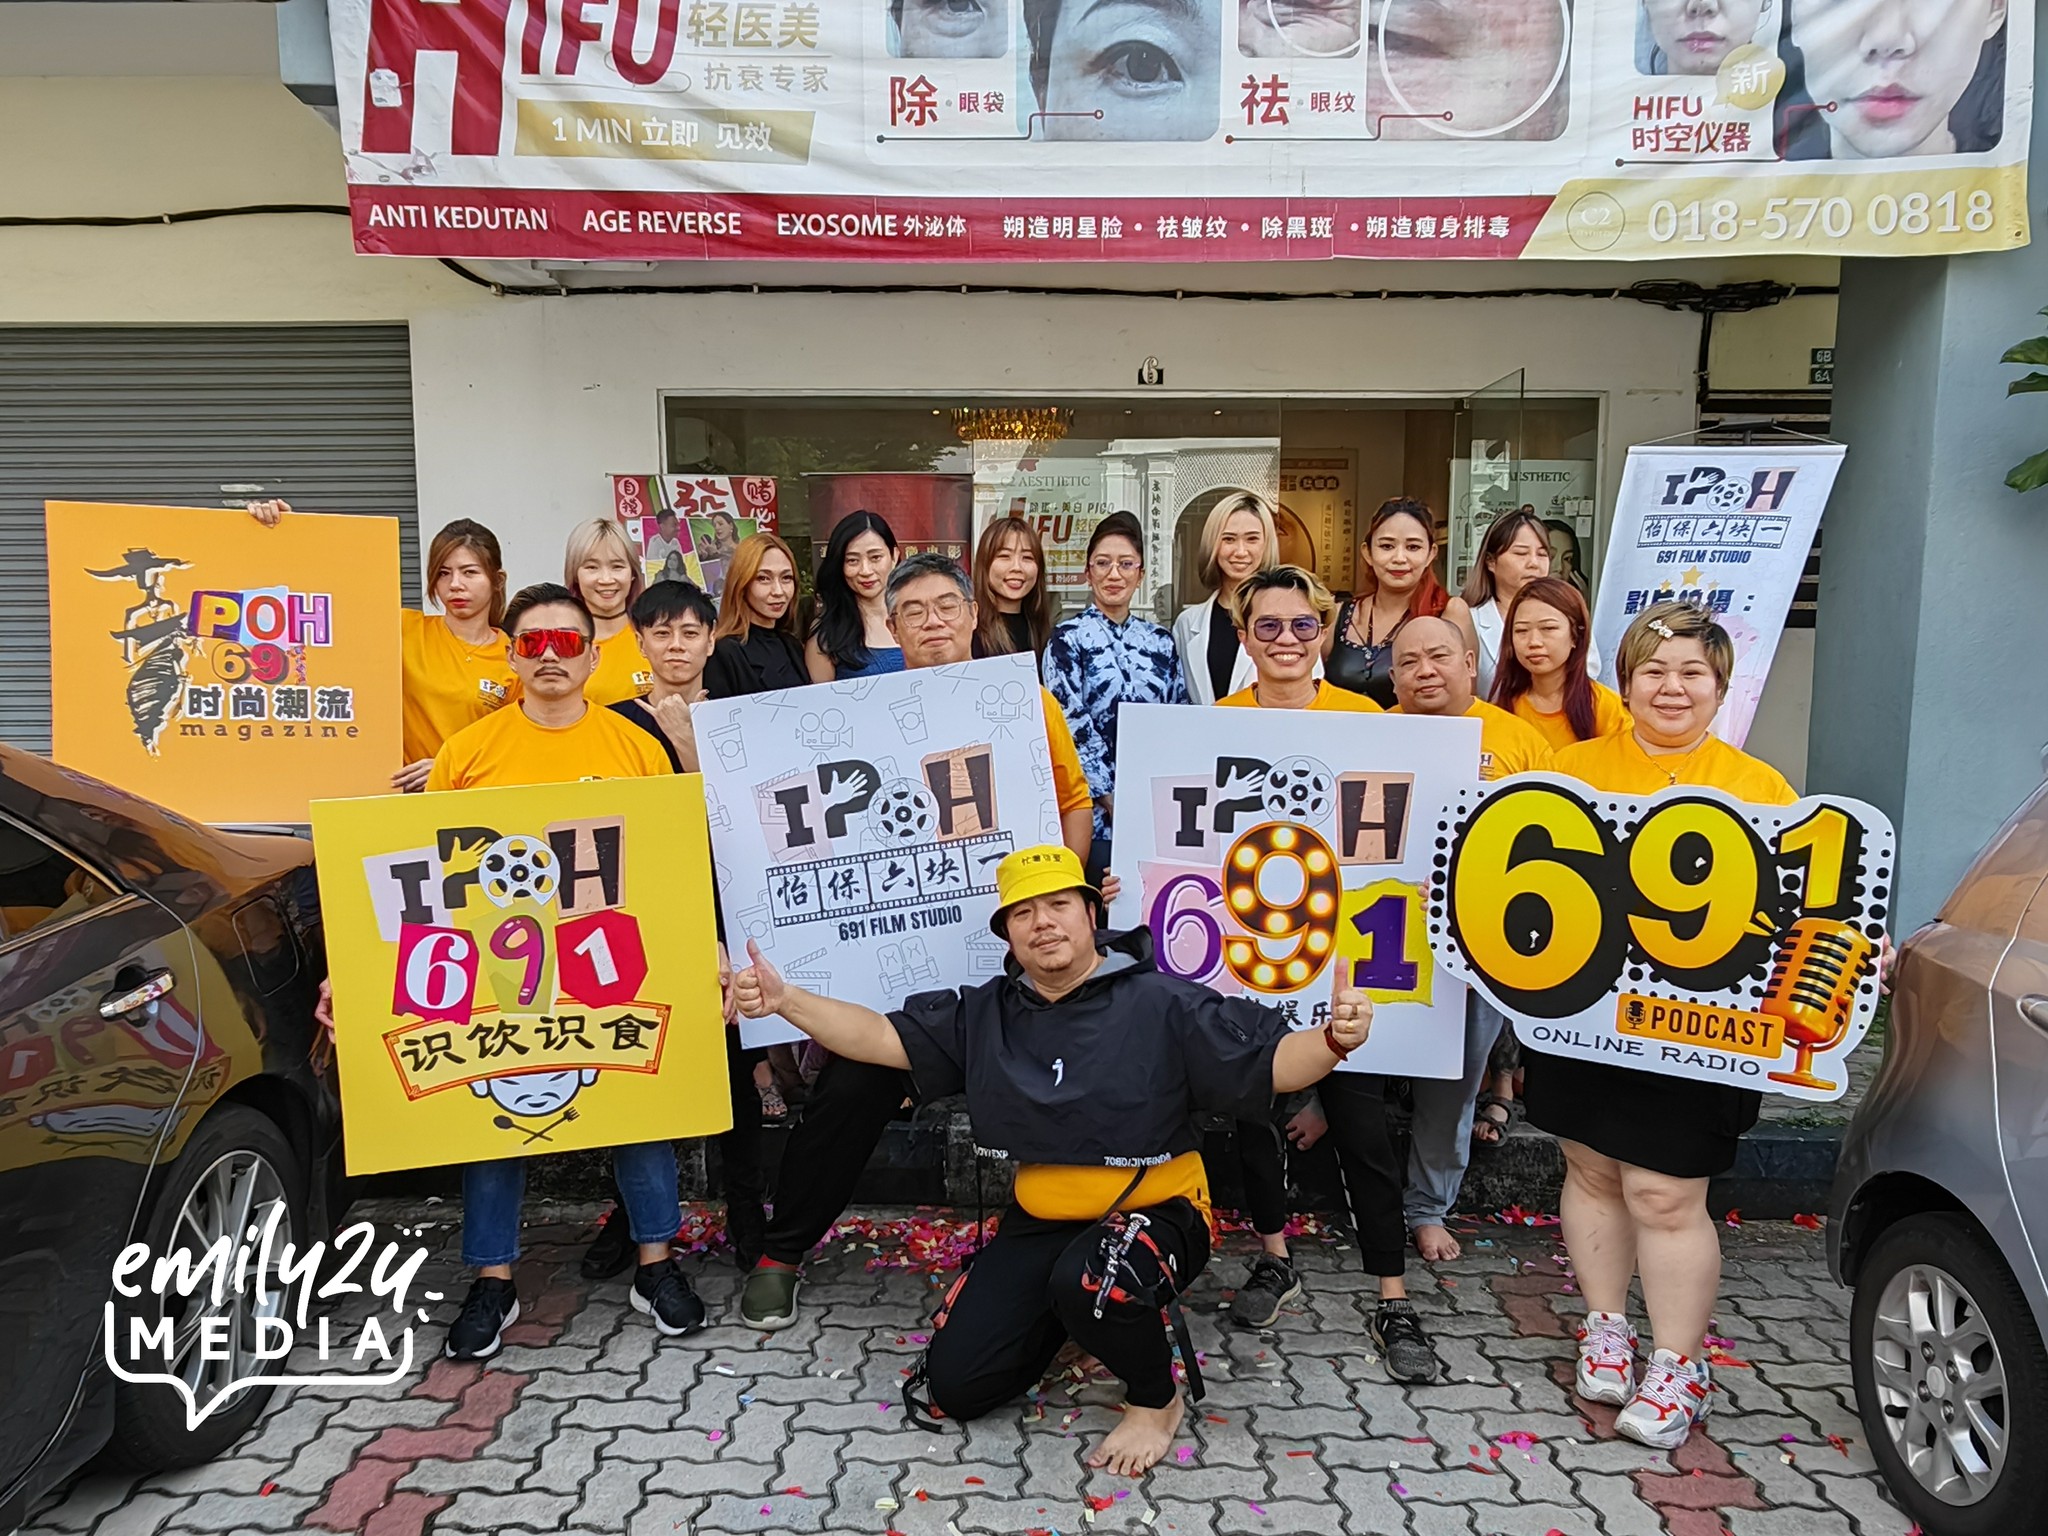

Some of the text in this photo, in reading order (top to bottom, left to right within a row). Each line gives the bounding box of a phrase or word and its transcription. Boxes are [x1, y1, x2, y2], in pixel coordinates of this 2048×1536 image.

[687, 2, 821, 50] 轻医美
[703, 62, 830, 92] 抗衰专家
[1730, 61, 1769, 97] 新
[889, 74, 1004, 128] 除 眼袋
[1240, 73, 1357, 126] 祛 眼纹
[1633, 95, 1704, 122] HIFU
[552, 117, 774, 152] 1 MIN 立即 见效
[1631, 122, 1752, 155] 时空仪器
[368, 205, 428, 229] ANTI
[434, 205, 548, 231] KEDUTAN
[583, 210, 633, 234] AGE
[638, 211, 743, 235] REVERSE
[777, 213, 898, 237] EXOSOME
[903, 215, 967, 238] 外泌体
[1003, 215, 1123, 239] 朔造明星脸
[1156, 215, 1229, 239] 祛皱纹
[1261, 215, 1334, 239] 除黑斑
[1648, 189, 1995, 242] 018-570 0818
[1816, 350, 1832, 363] 6B
[1644, 519, 1785, 543] 怡保六块一
[1656, 549, 1752, 565] 691 FILM STUDIO
[187, 685, 353, 719] 时尚潮流
[179, 720, 360, 741] magazine
[1148, 820, 1419, 994] 691
[1453, 785, 1852, 992] 691
[838, 904, 963, 942] 691 FILM STUDIO
[405, 913, 621, 1010] 691
[400, 1012, 660, 1074] 识饮识食
[1650, 1005, 1775, 1049] PODCAST
[1532, 1026, 1762, 1077] ONLINE RADIO
